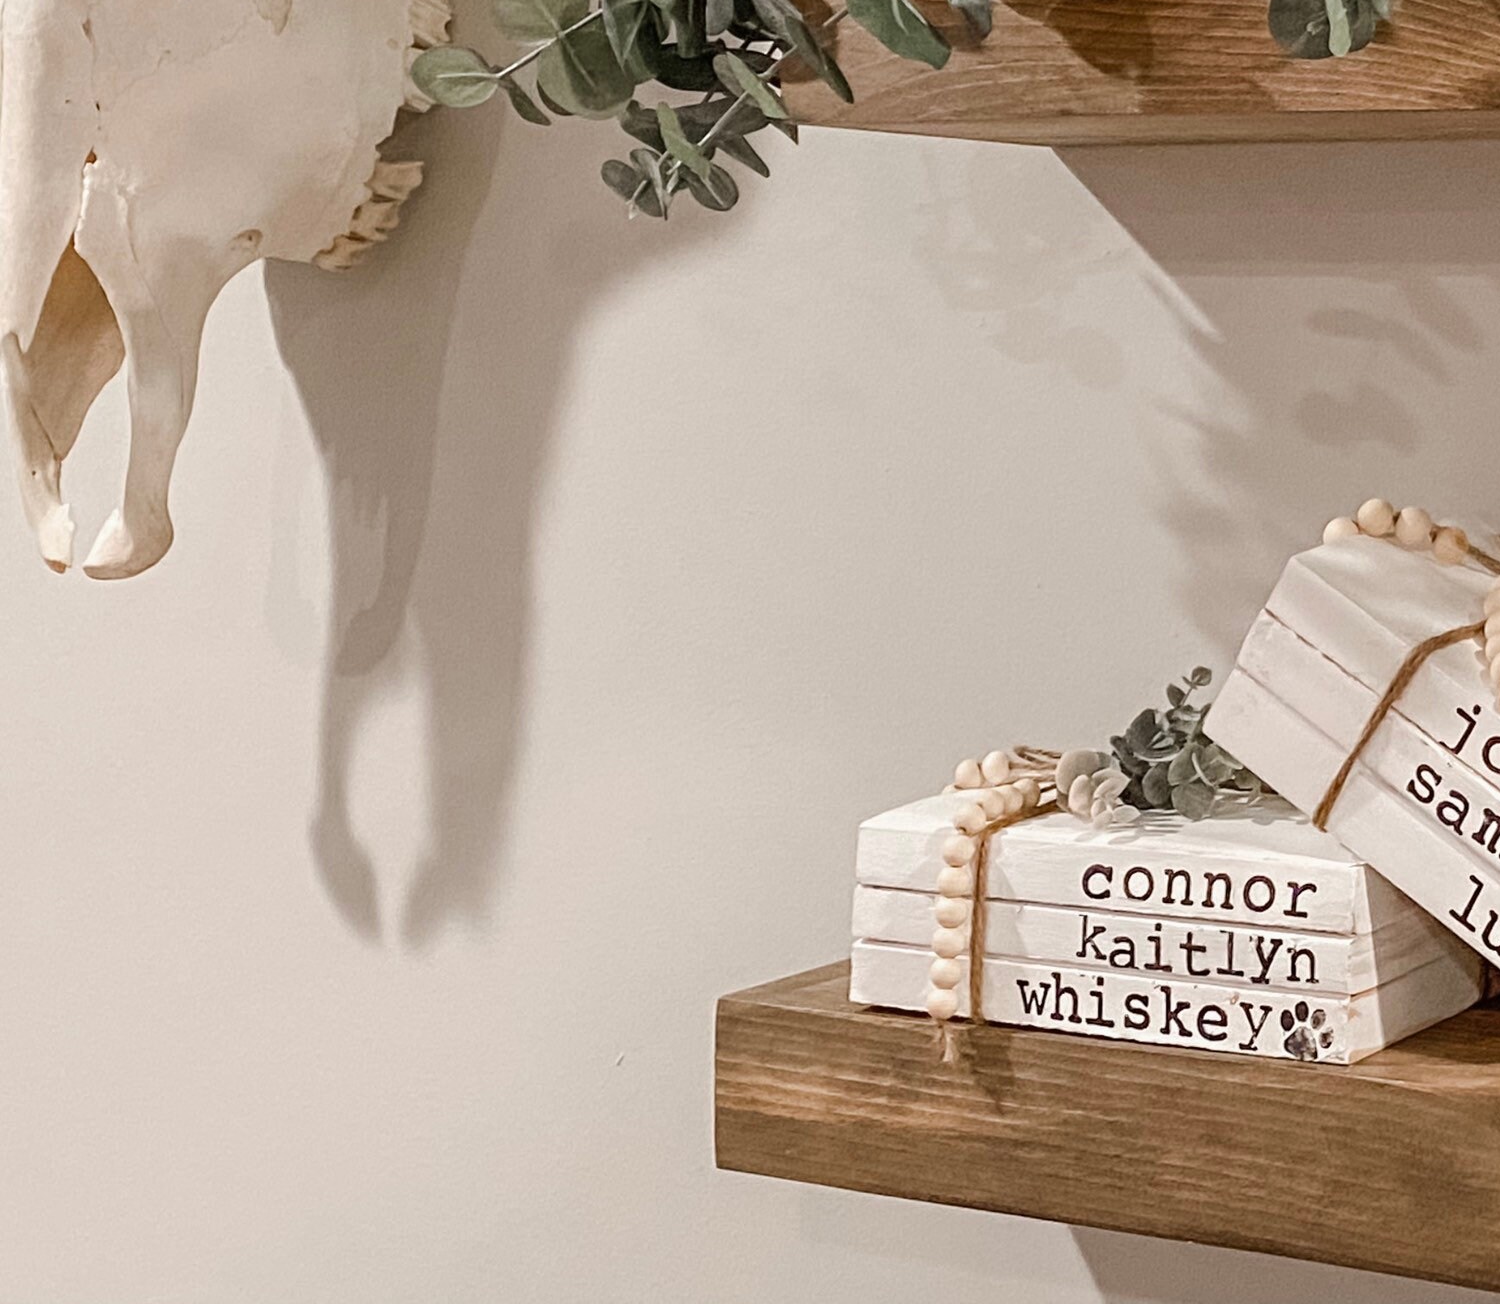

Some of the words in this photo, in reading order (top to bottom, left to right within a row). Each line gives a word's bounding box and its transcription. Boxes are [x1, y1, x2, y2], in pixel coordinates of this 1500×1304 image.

[1081, 863, 1318, 919] connor
[1075, 913, 1320, 985] kaitlyn
[1015, 971, 1274, 1052] whiskey
